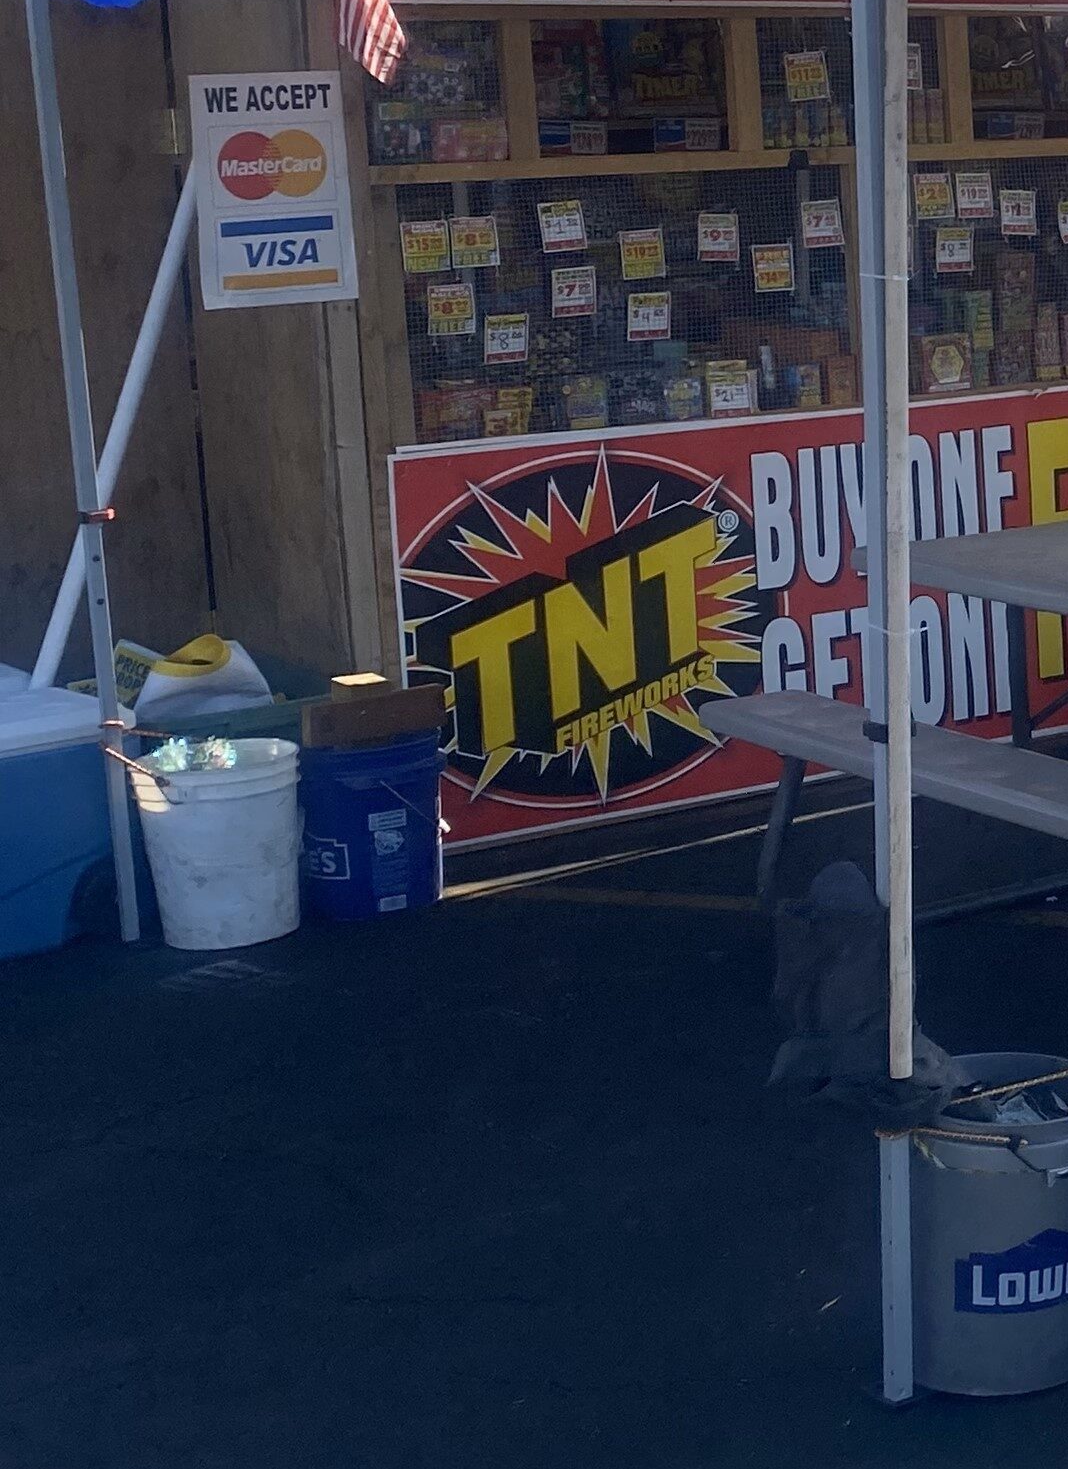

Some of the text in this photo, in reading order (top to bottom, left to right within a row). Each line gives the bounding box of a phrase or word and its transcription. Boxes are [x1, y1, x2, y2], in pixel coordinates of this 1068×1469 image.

[204, 83, 331, 113] WE ACCEPT
[220, 154, 322, 178] MasterCard
[241, 238, 320, 269] VISA
[451, 517, 718, 755] TNT
[556, 653, 717, 753] FIREWORKS
